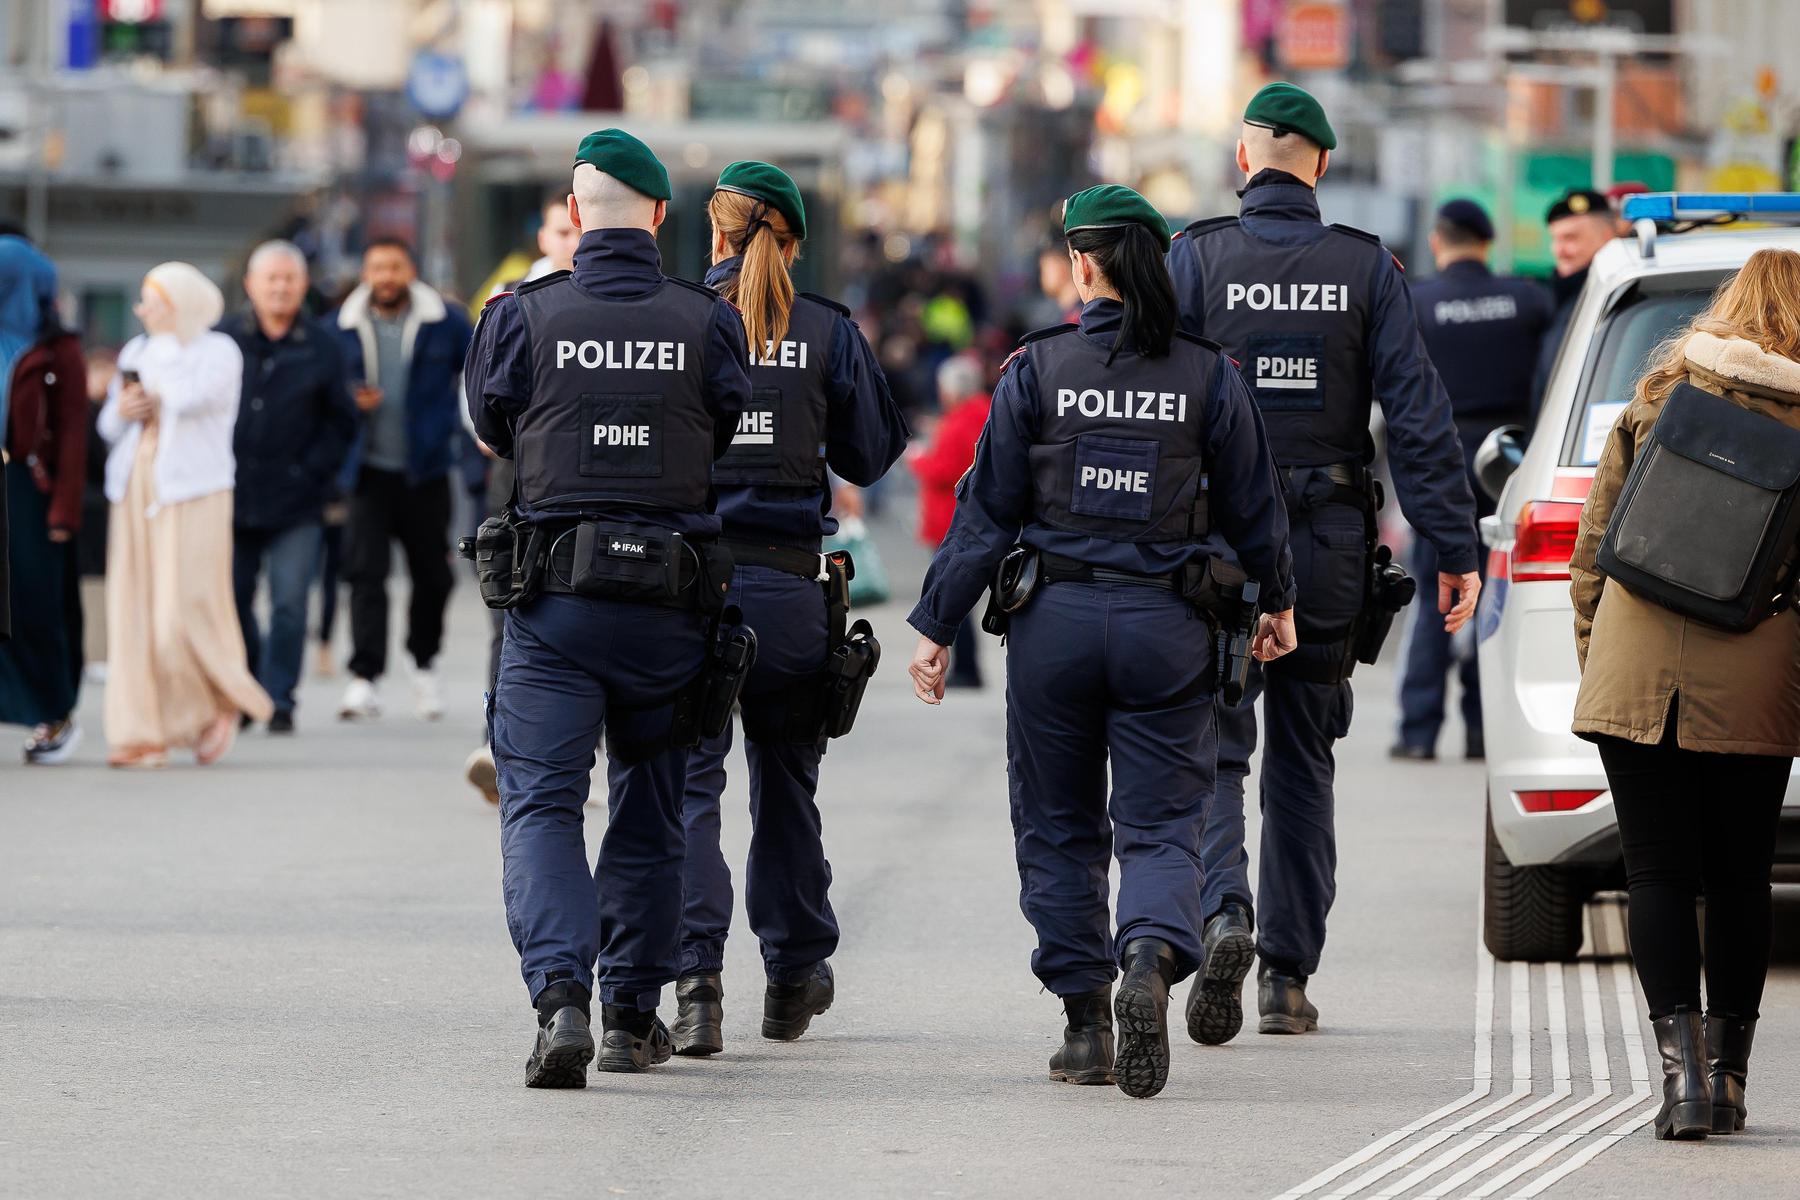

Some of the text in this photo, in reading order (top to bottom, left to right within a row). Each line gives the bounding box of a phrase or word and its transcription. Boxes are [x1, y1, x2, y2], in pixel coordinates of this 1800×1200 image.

[1227, 283, 1348, 311] POLIZEI
[557, 341, 685, 370] POLIZEI
[1257, 356, 1318, 378] PDHE
[1058, 389, 1186, 422] POLIZEI
[736, 411, 773, 433] HE
[594, 425, 650, 446] PDHE
[1081, 466, 1149, 493] PDHE
[622, 543, 644, 553] IFAK
